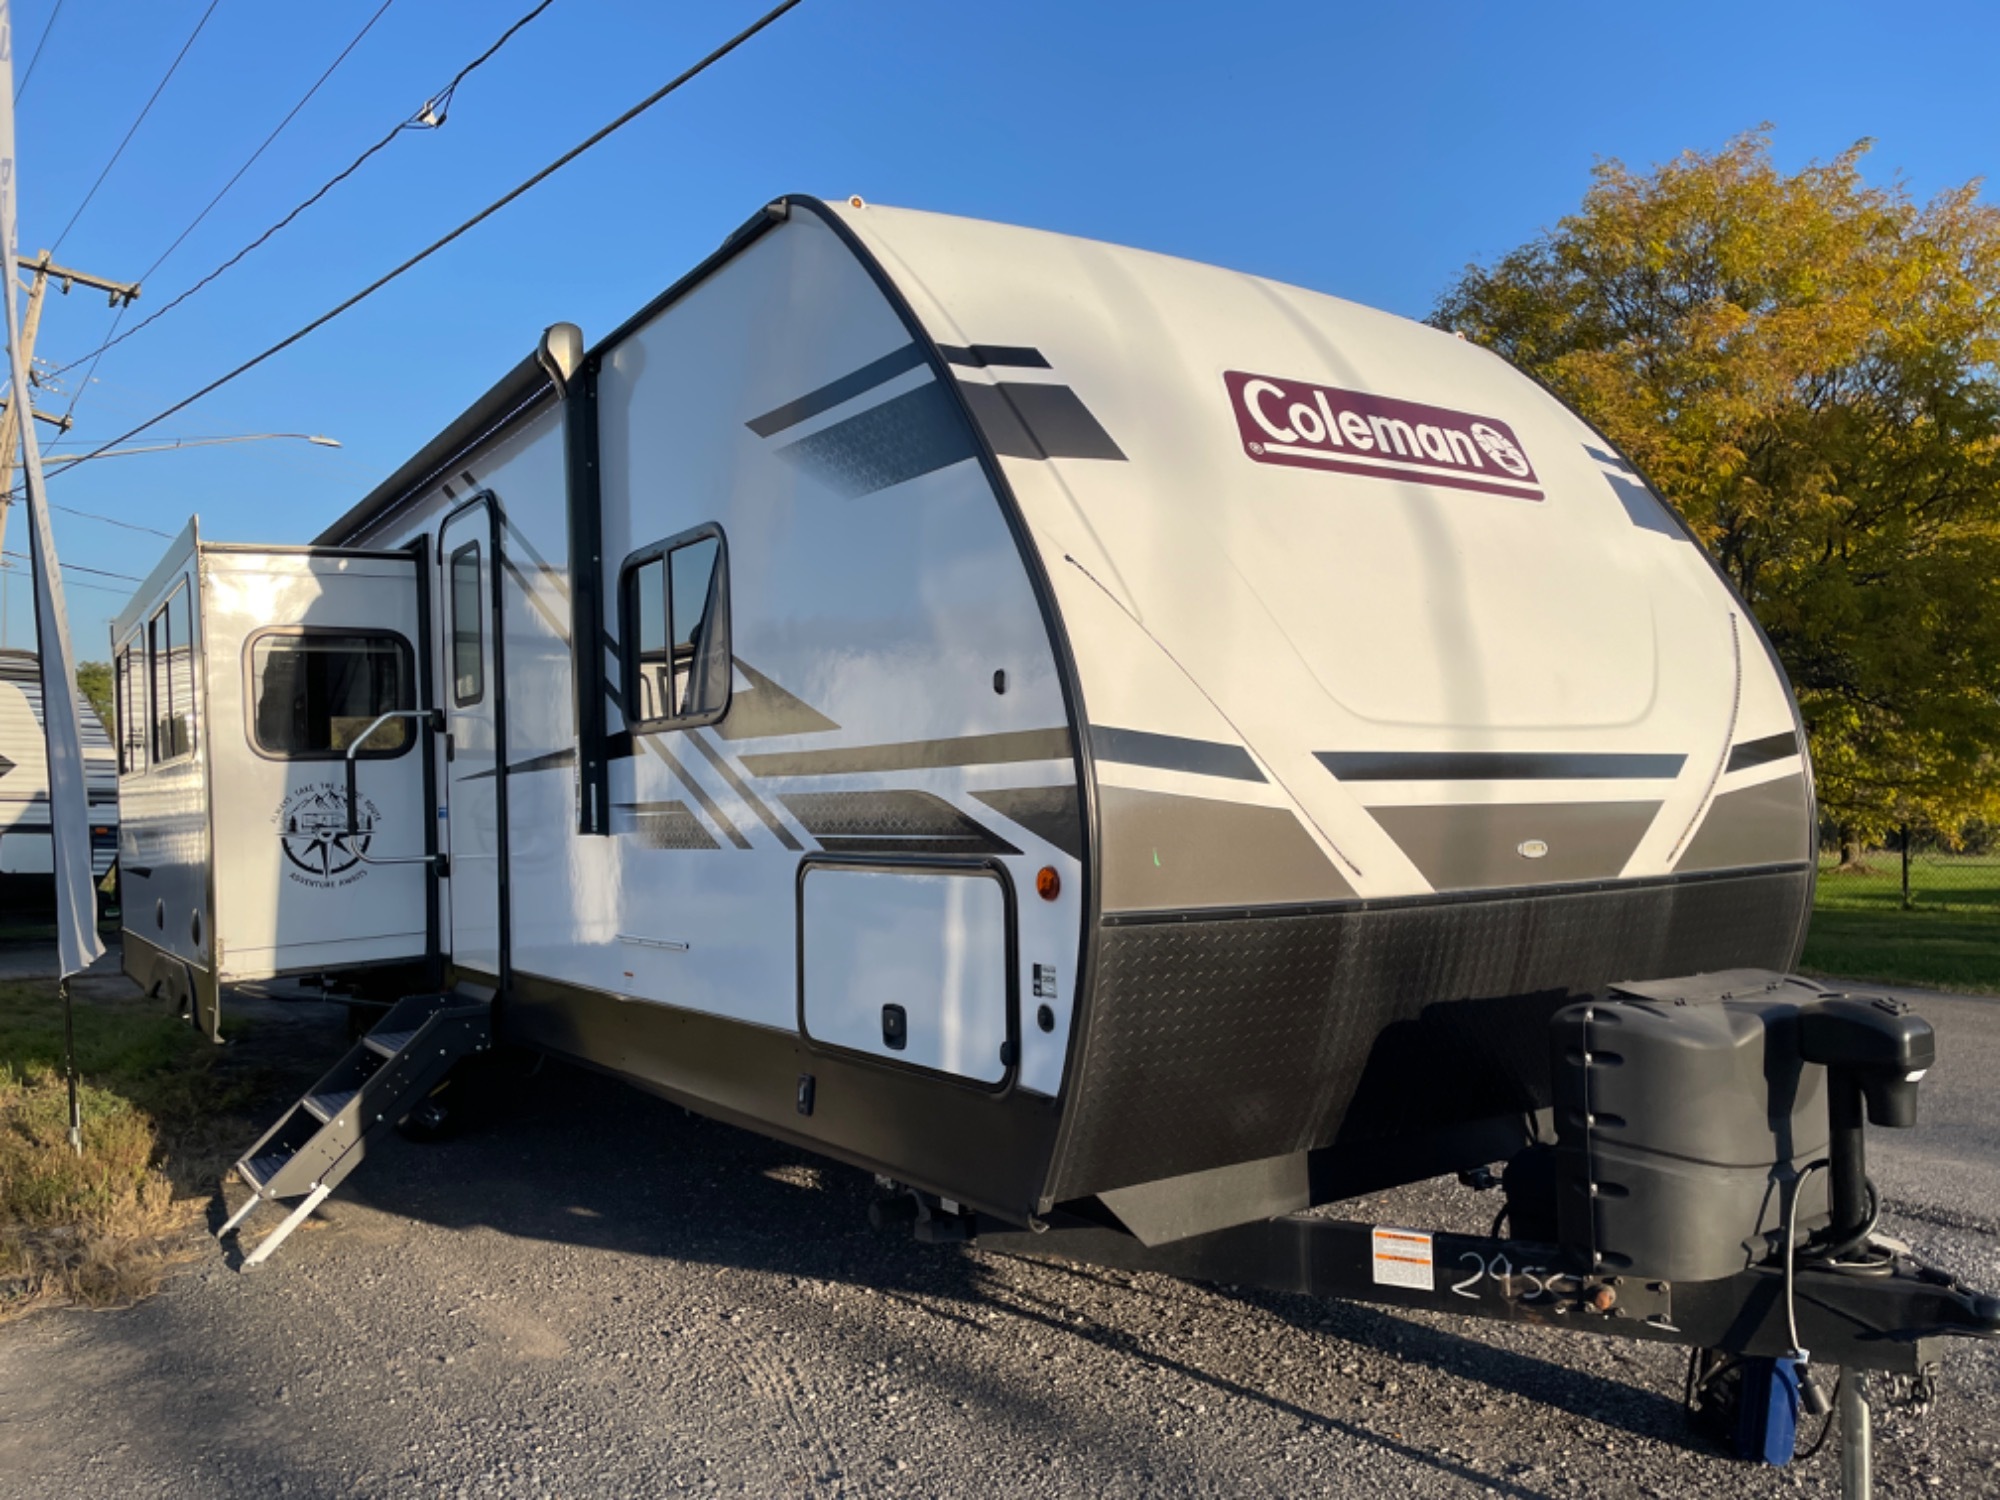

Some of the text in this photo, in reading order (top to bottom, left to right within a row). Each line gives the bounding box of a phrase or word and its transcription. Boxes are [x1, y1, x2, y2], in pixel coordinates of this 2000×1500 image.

[1243, 379, 1484, 468] Coleman
[294, 784, 315, 797] TAKE
[320, 781, 335, 790] THE
[289, 872, 336, 889] ADVENTURE
